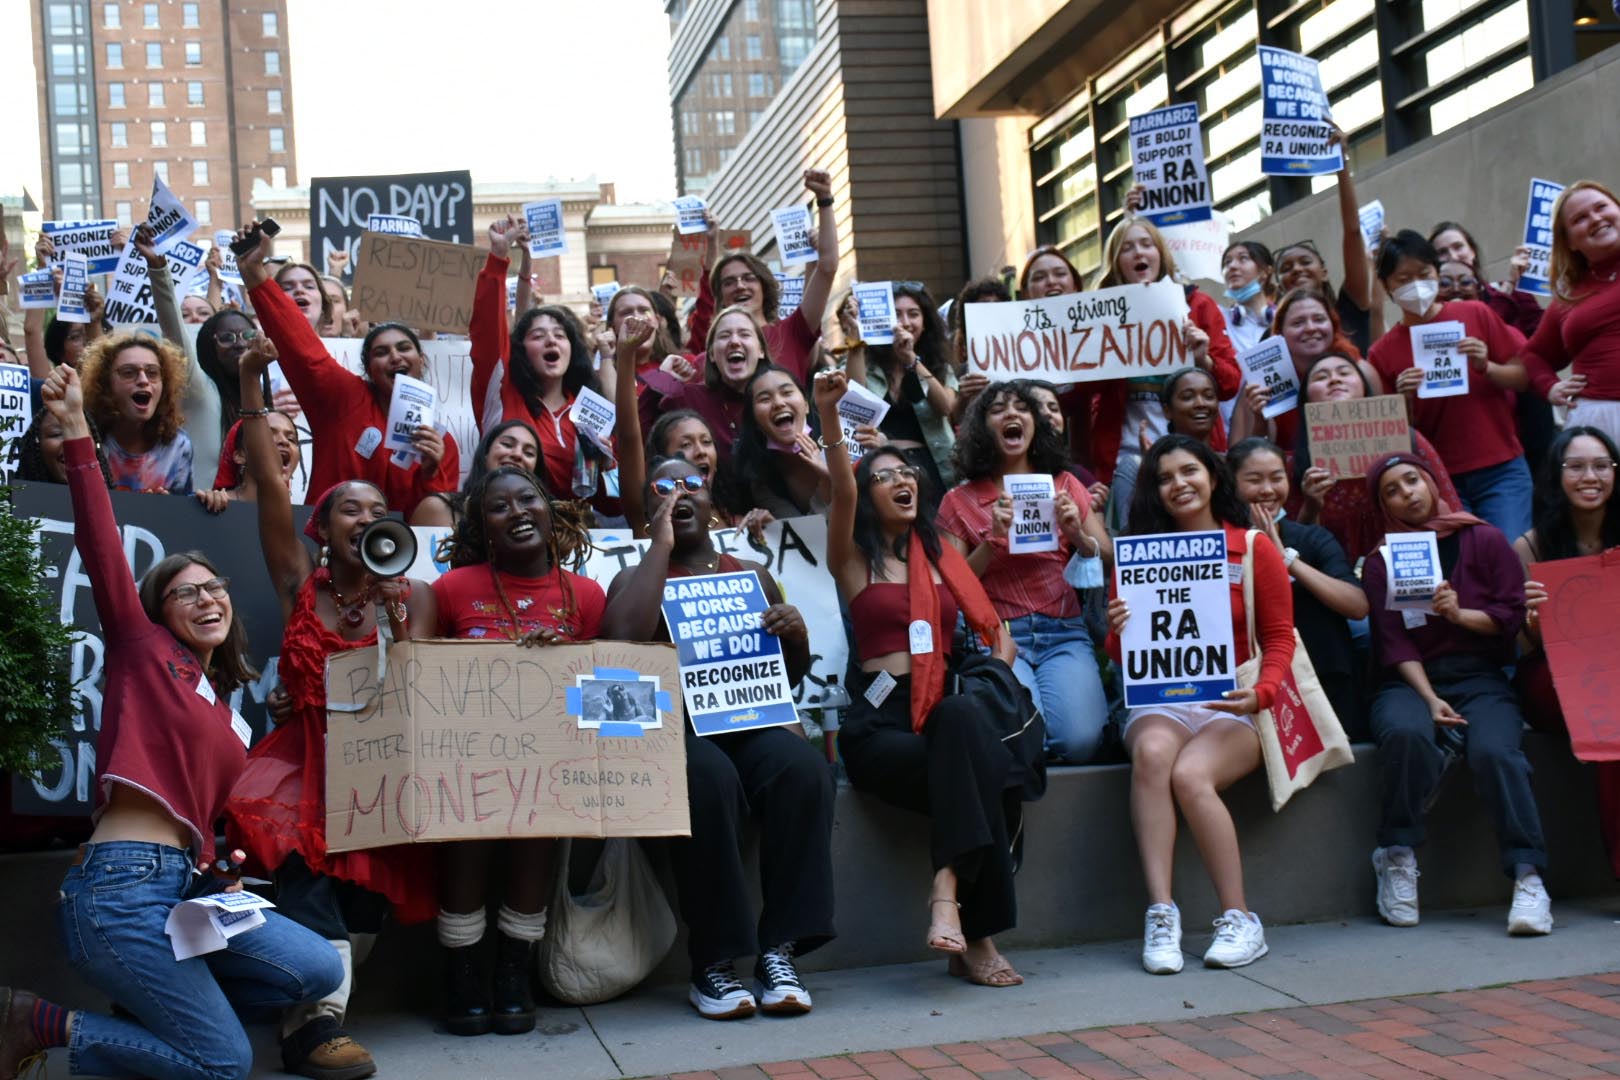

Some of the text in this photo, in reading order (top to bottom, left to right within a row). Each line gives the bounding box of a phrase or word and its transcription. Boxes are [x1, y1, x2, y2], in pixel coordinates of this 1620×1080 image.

[1276, 102, 1298, 116] WE
[1131, 109, 1196, 134] BARNARD:
[1264, 123, 1335, 139] RECOGNIZE
[1137, 127, 1191, 149] BE BOLD!
[1265, 141, 1335, 156] RA UNION!
[1137, 144, 1193, 164] SUPPORT
[1136, 158, 1198, 184] THE RA
[319, 182, 466, 229] NO PAY?
[1136, 182, 1206, 211] UNION!
[148, 205, 165, 223] RA
[50, 228, 115, 248] ECOGNIZE
[794, 230, 808, 240] RA
[114, 279, 135, 295] THE
[416, 271, 435, 298] 4
[359, 285, 471, 328] RA UNION
[971, 318, 1187, 374] UNIONIZATION
[1434, 357, 1451, 368] RA
[1264, 372, 1281, 387] RA
[1426, 368, 1461, 381] UNION
[405, 411, 422, 423] RA
[1332, 403, 1341, 419] A
[1312, 418, 1408, 442] INSTITUTION
[1023, 509, 1041, 521] RA
[1015, 521, 1051, 535] UNION
[1118, 537, 1222, 563] BARNARD:
[1121, 563, 1224, 586] RECOGNIZE
[1395, 579, 1434, 587] RECOGNIZE
[664, 578, 754, 601] BARNARD
[1156, 587, 1191, 604] THE
[682, 597, 747, 618] WORKS
[1151, 609, 1200, 641] RA
[693, 633, 760, 660] WE DO!
[1127, 645, 1228, 680] UNION
[684, 660, 781, 688] RECOGNIZE
[346, 655, 554, 723] BARNARD
[693, 683, 782, 711] RA UNION!
[343, 730, 539, 765] BETTER HAVE OUR
[562, 768, 653, 787] BARNARD RA
[344, 760, 543, 838] MONEY!
[582, 794, 626, 808] UNION
